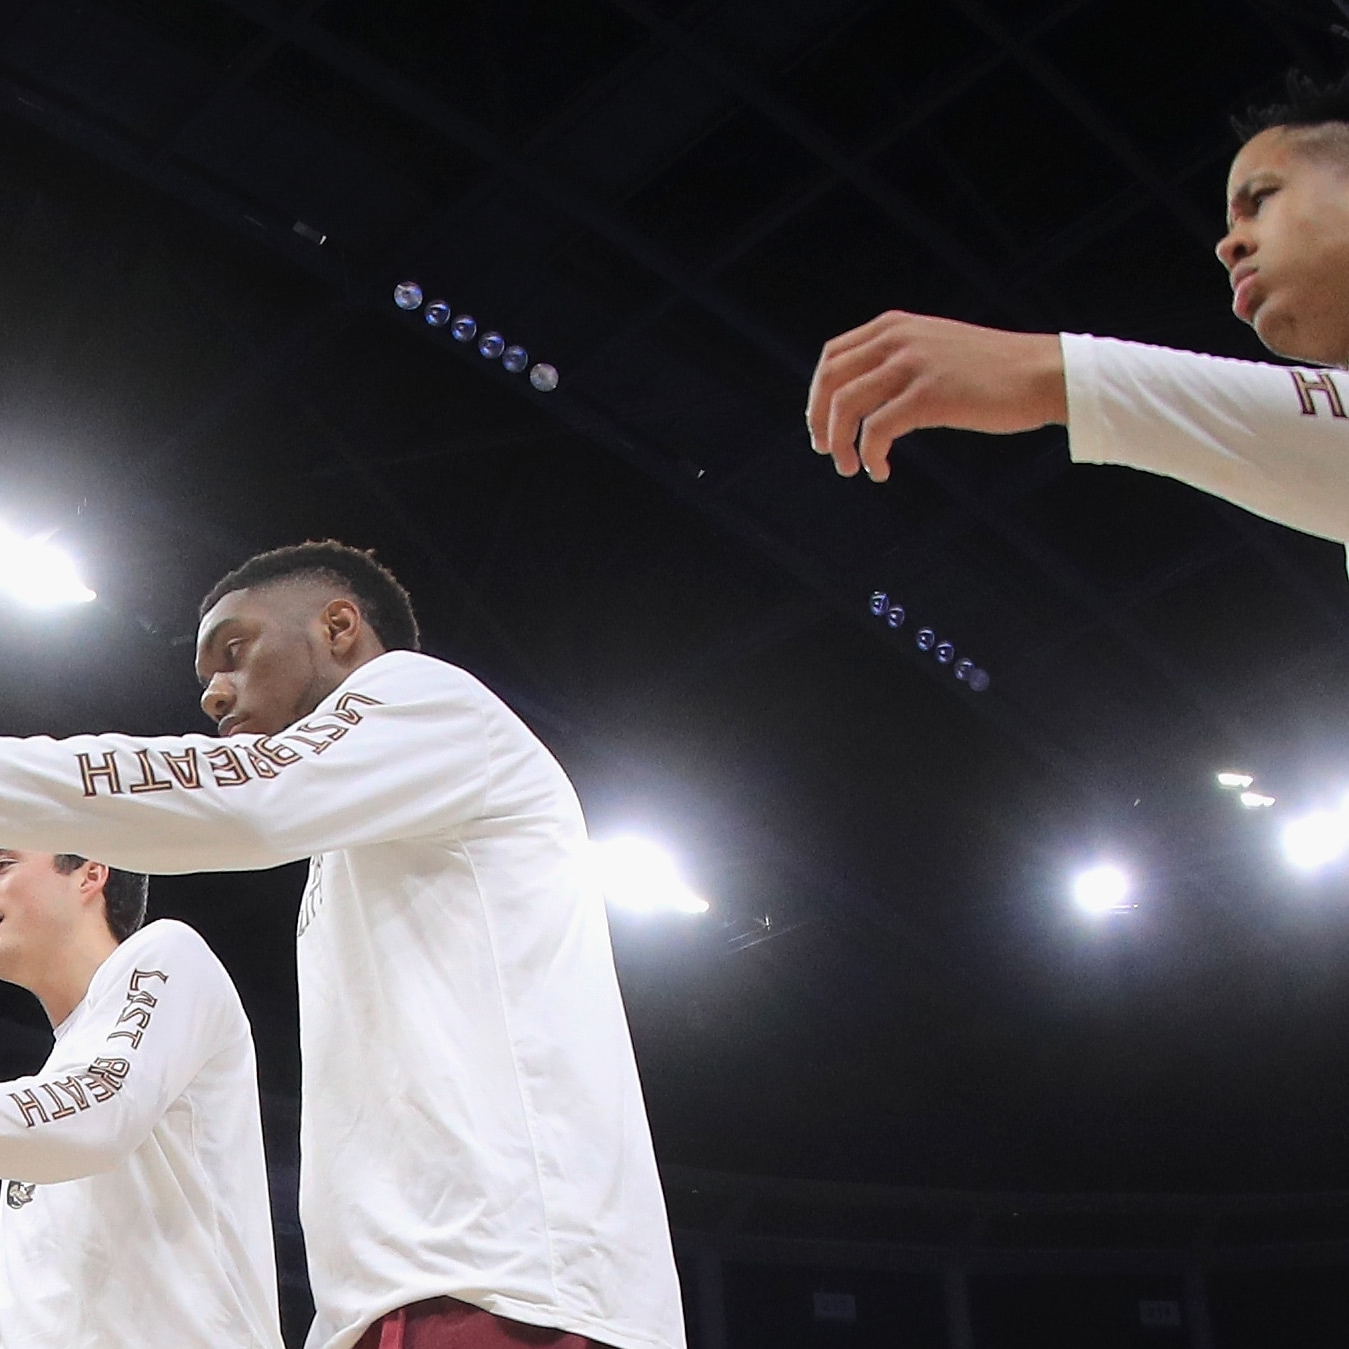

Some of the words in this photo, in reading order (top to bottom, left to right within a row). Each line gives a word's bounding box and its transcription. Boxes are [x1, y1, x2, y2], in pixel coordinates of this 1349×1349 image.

[285, 691, 384, 755] LAST
[106, 967, 170, 1051] LAST
[8, 1056, 132, 1128] BREATH
